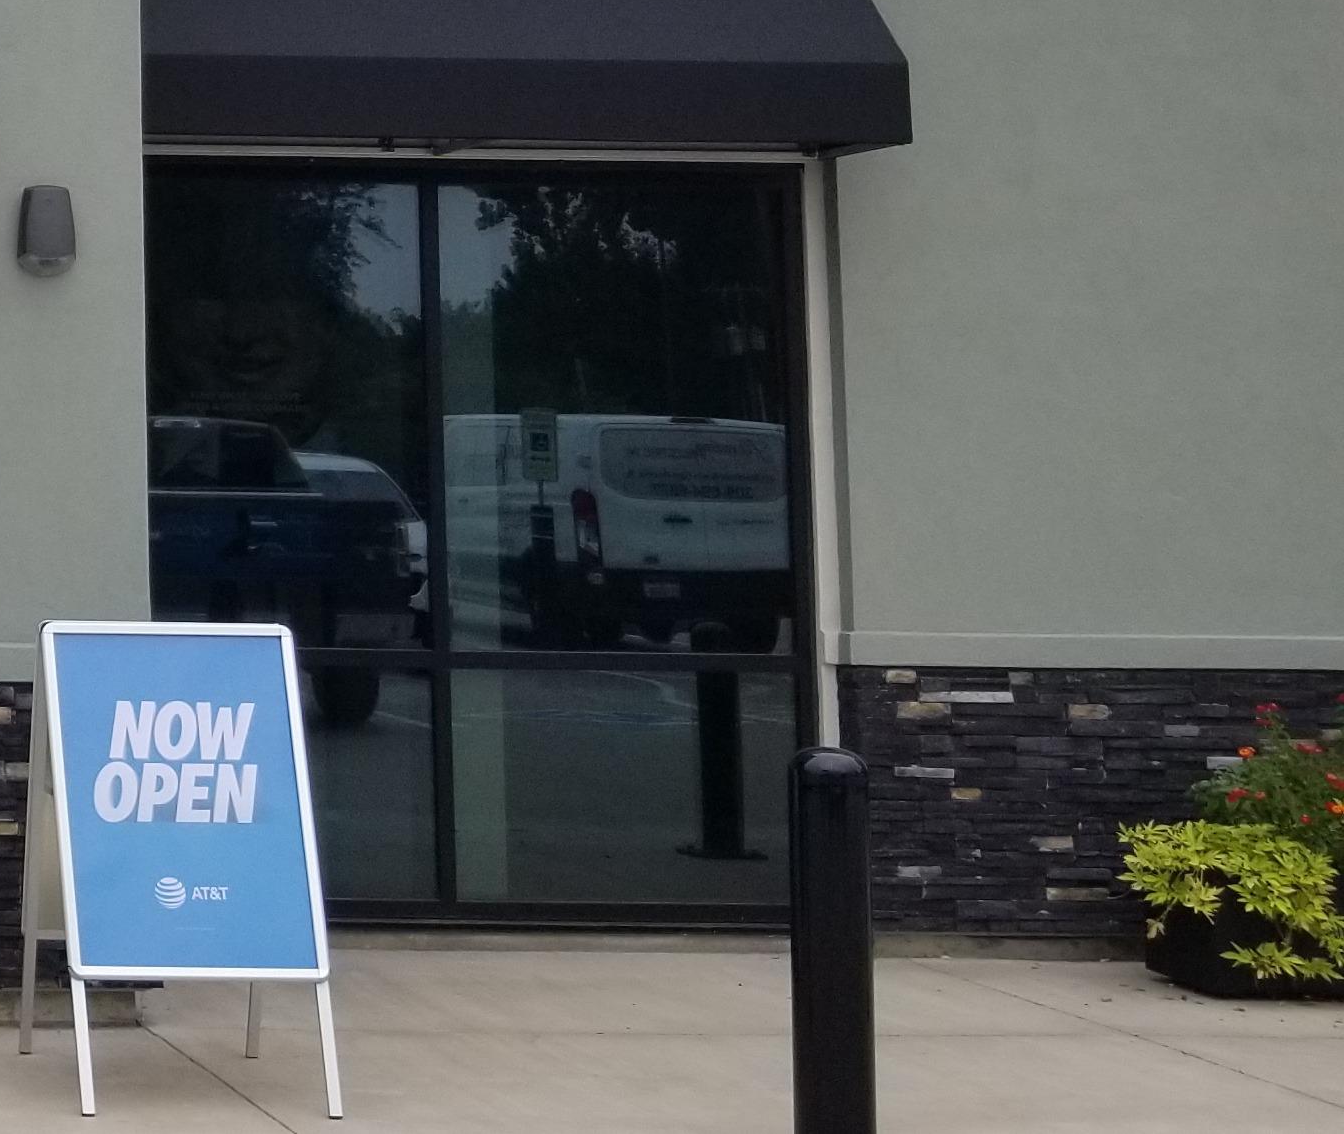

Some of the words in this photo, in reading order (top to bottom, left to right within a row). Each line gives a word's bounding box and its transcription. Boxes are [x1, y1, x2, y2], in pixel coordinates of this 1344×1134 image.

[109, 700, 255, 761] NOW
[93, 762, 258, 824] OPEN
[191, 886, 229, 902] AT&T
